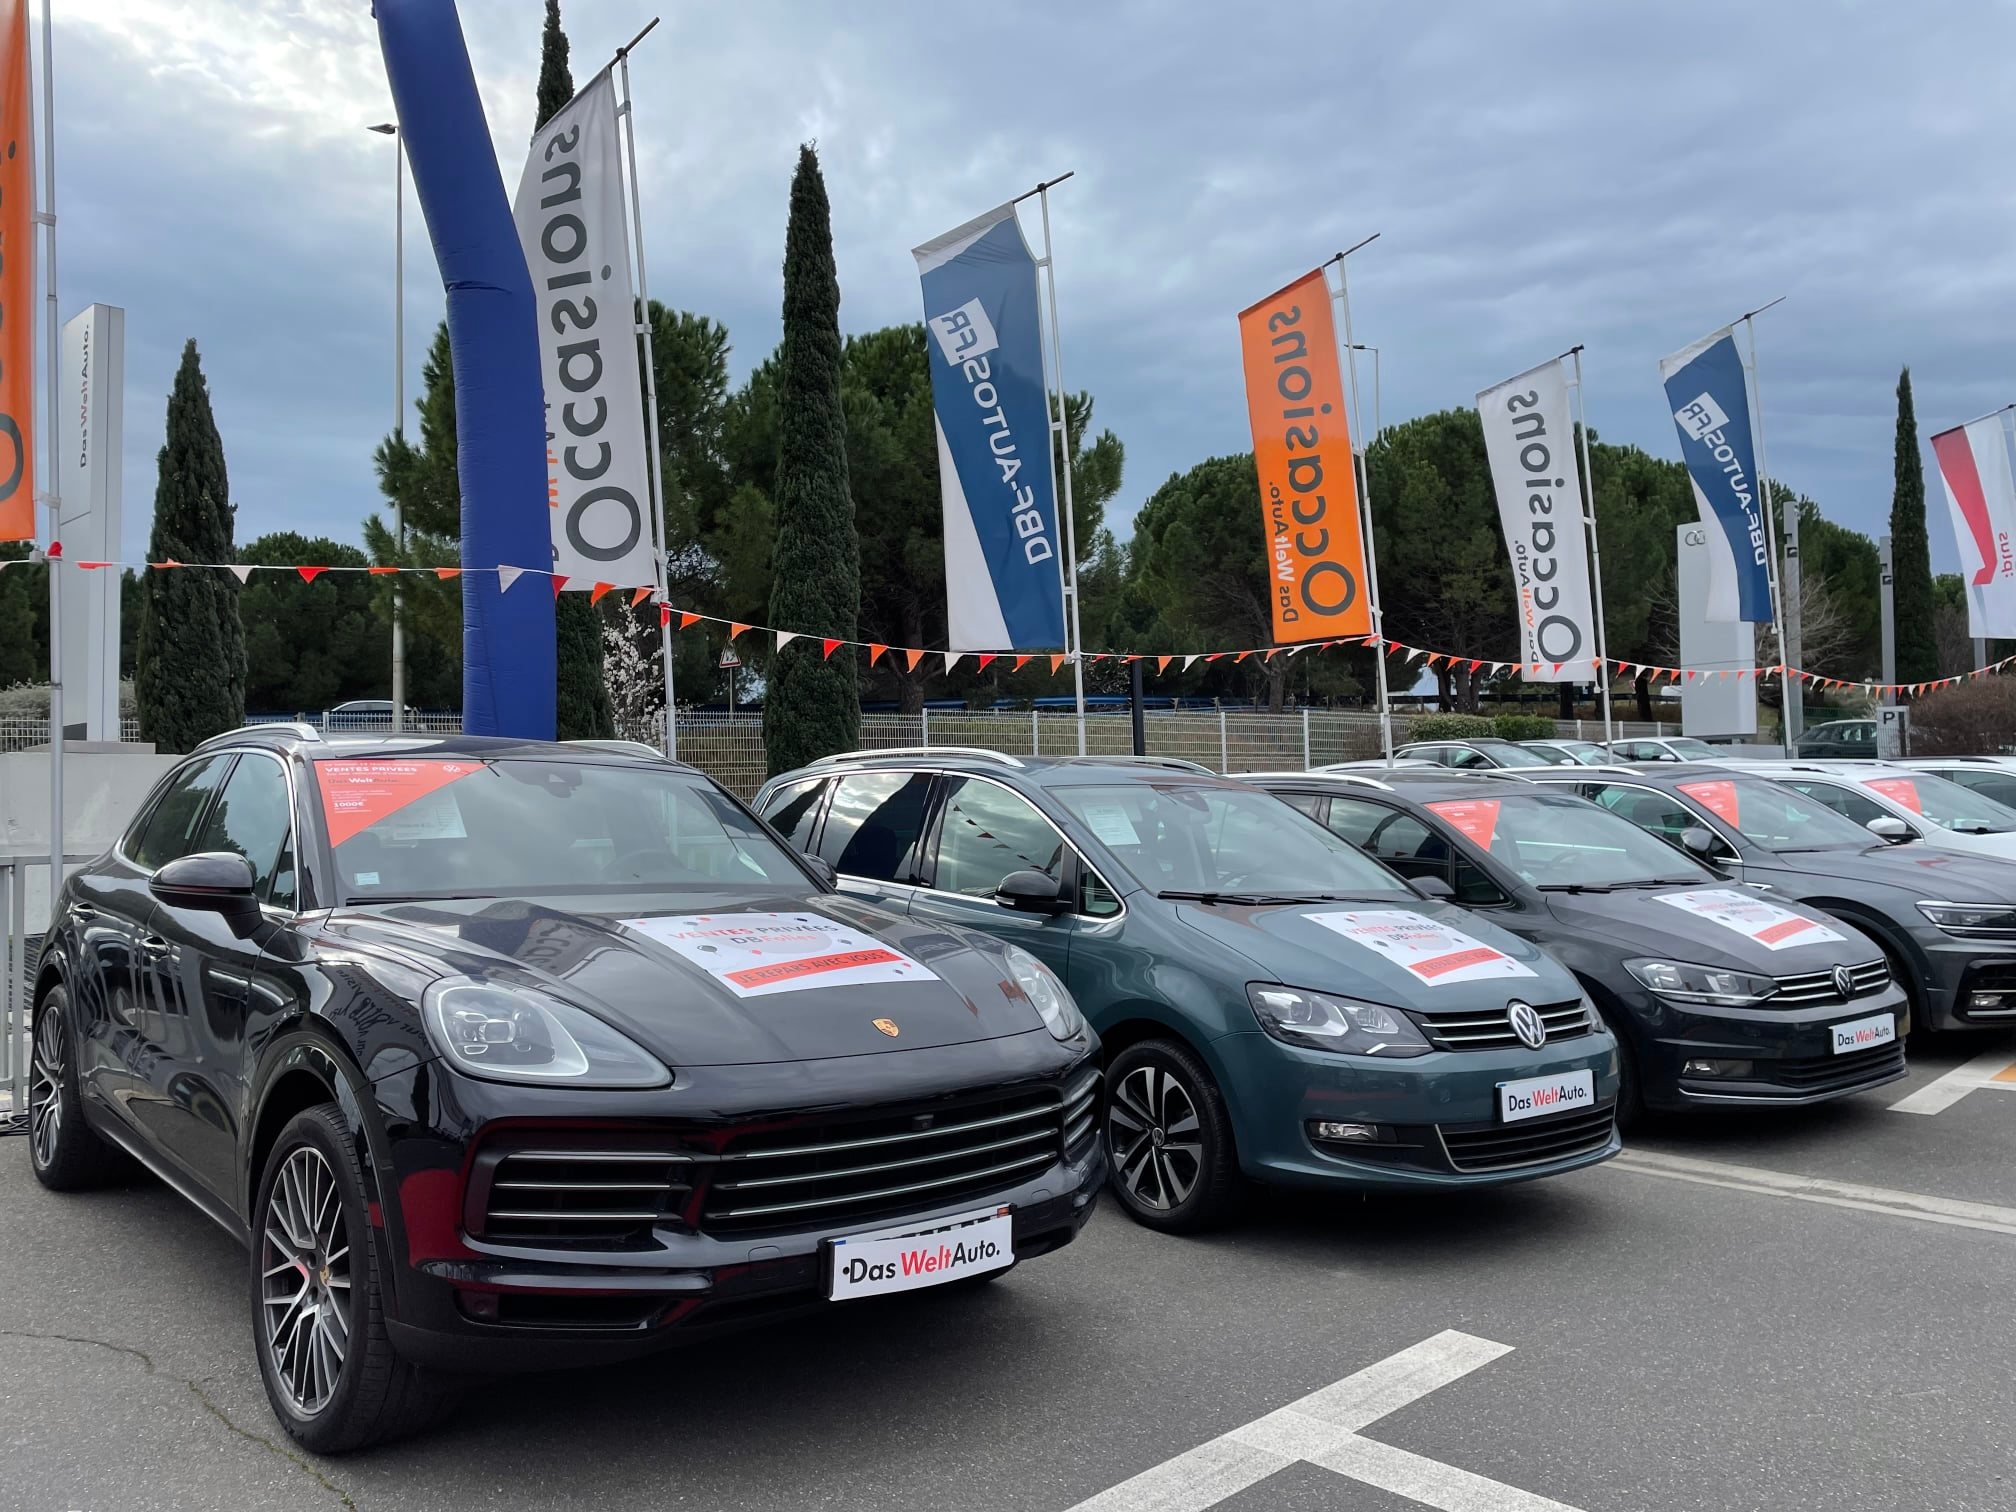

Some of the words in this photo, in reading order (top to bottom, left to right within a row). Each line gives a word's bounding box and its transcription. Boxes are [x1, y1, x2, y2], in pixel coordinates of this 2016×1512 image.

[1883, 711, 1895, 725] P
[669, 927, 754, 940] VENTES
[811, 956, 848, 969] AVEC
[847, 951, 885, 962] VOUS
[1837, 1033, 1855, 1046] Das
[1508, 1095, 1531, 1112] Das
[1532, 1085, 1587, 1107] WeltAuto.
[850, 1257, 896, 1284] Das
[901, 1239, 1000, 1277] WeltAuto.
